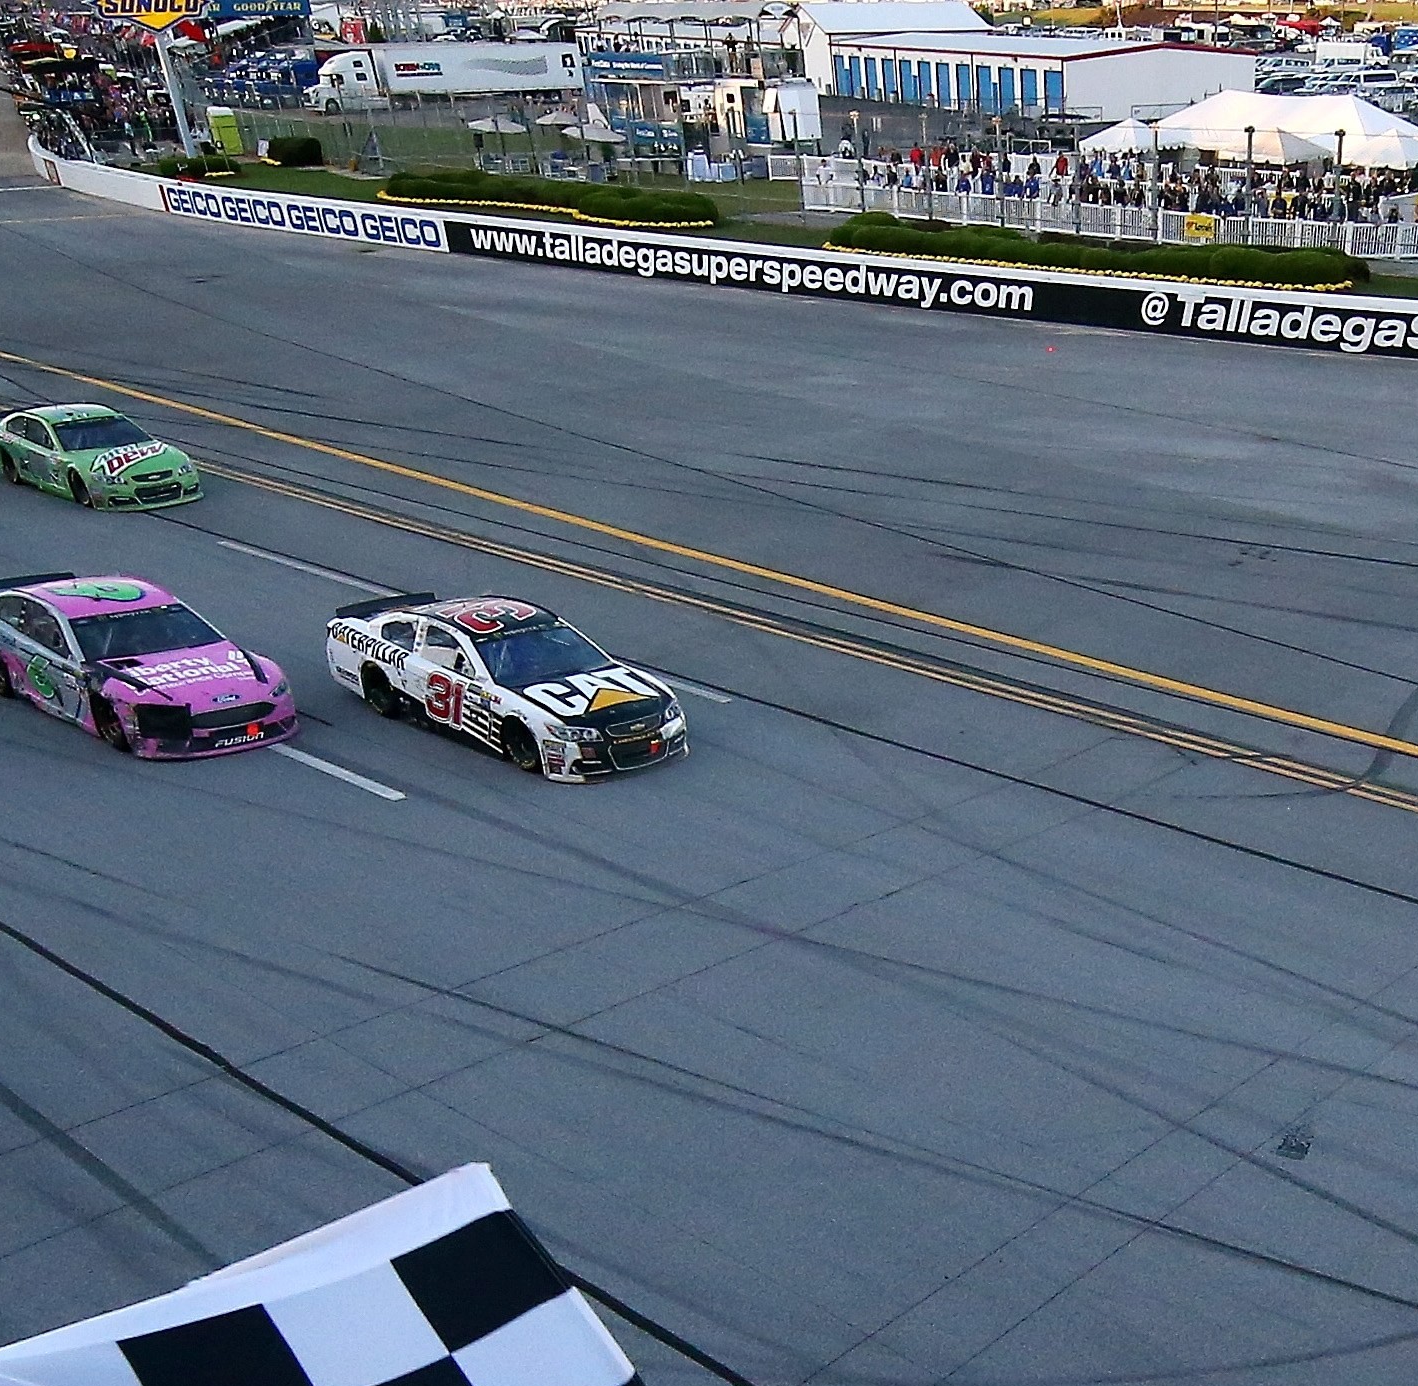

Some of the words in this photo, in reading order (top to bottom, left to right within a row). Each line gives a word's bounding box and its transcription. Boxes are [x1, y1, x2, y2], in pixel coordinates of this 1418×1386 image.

[234, 0, 301, 12] GOODYEAR
[166, 187, 222, 218] GEICO
[222, 196, 286, 227] GEICO
[287, 204, 359, 236] GEICO
[361, 213, 442, 248] GEICO
[470, 227, 1034, 311] www.talladegasuperspeedway.com
[330, 621, 411, 671] CATERPILLAR
[425, 670, 467, 732] 31
[522, 666, 662, 718] CAT
